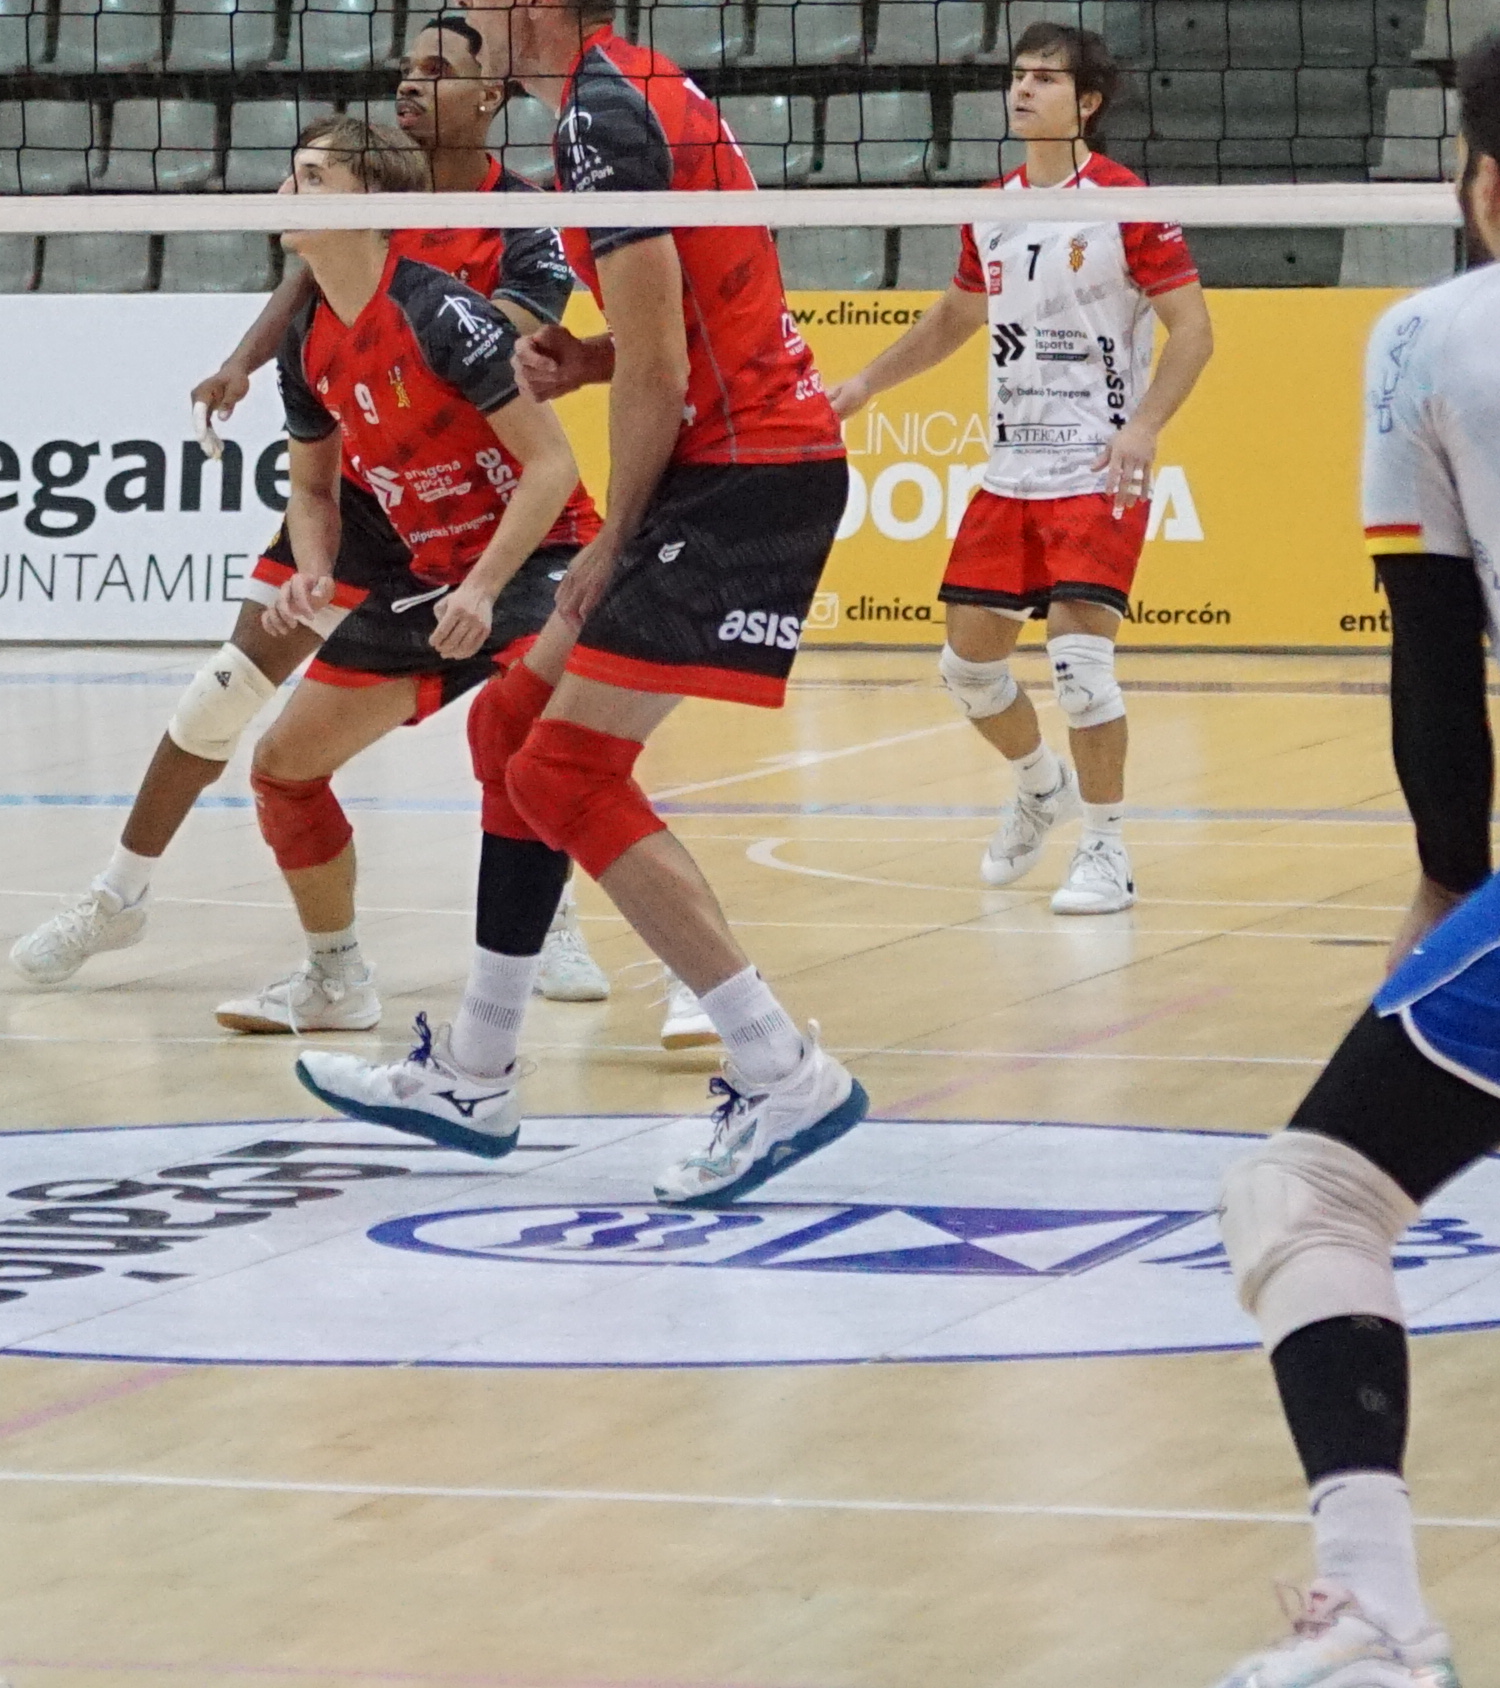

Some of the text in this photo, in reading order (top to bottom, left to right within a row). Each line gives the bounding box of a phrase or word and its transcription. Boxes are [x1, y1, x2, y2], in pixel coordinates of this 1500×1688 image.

[1026, 244, 1042, 282] 7
[354, 382, 380, 425] 9
[718, 610, 803, 651] asis
